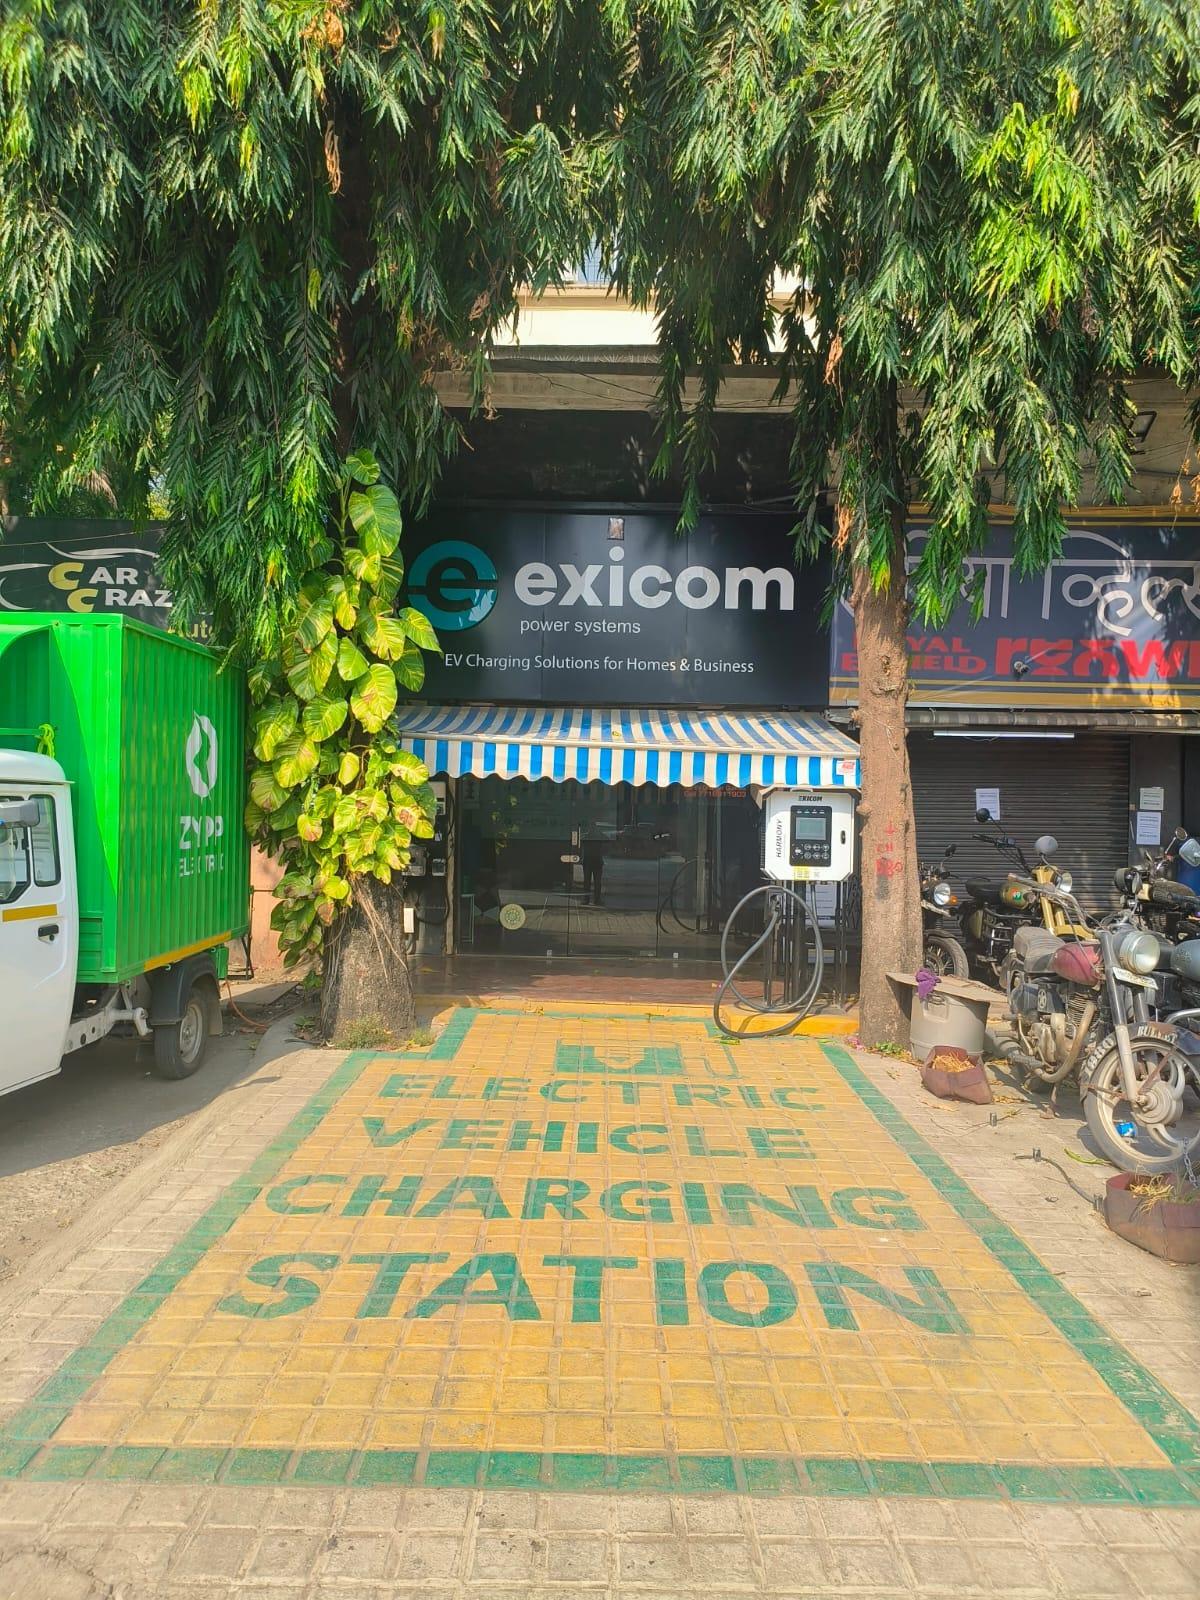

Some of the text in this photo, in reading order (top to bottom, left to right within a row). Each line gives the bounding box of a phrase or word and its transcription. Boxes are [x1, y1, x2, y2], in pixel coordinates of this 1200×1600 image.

[48, 562, 139, 591] CAR
[514, 546, 795, 611] exicom
[67, 588, 175, 613] CRAZ
[520, 619, 641, 636] power systems
[444, 654, 754, 673] EV Charging Solutions for Homes & Business
[841, 652, 987, 675] EIELD
[179, 815, 224, 850] ZYPP
[379, 1075, 826, 1112] ELECTRIC
[361, 1116, 816, 1160] VEHICLE
[265, 1175, 929, 1231] CHARGING
[217, 1252, 976, 1336] STATION
